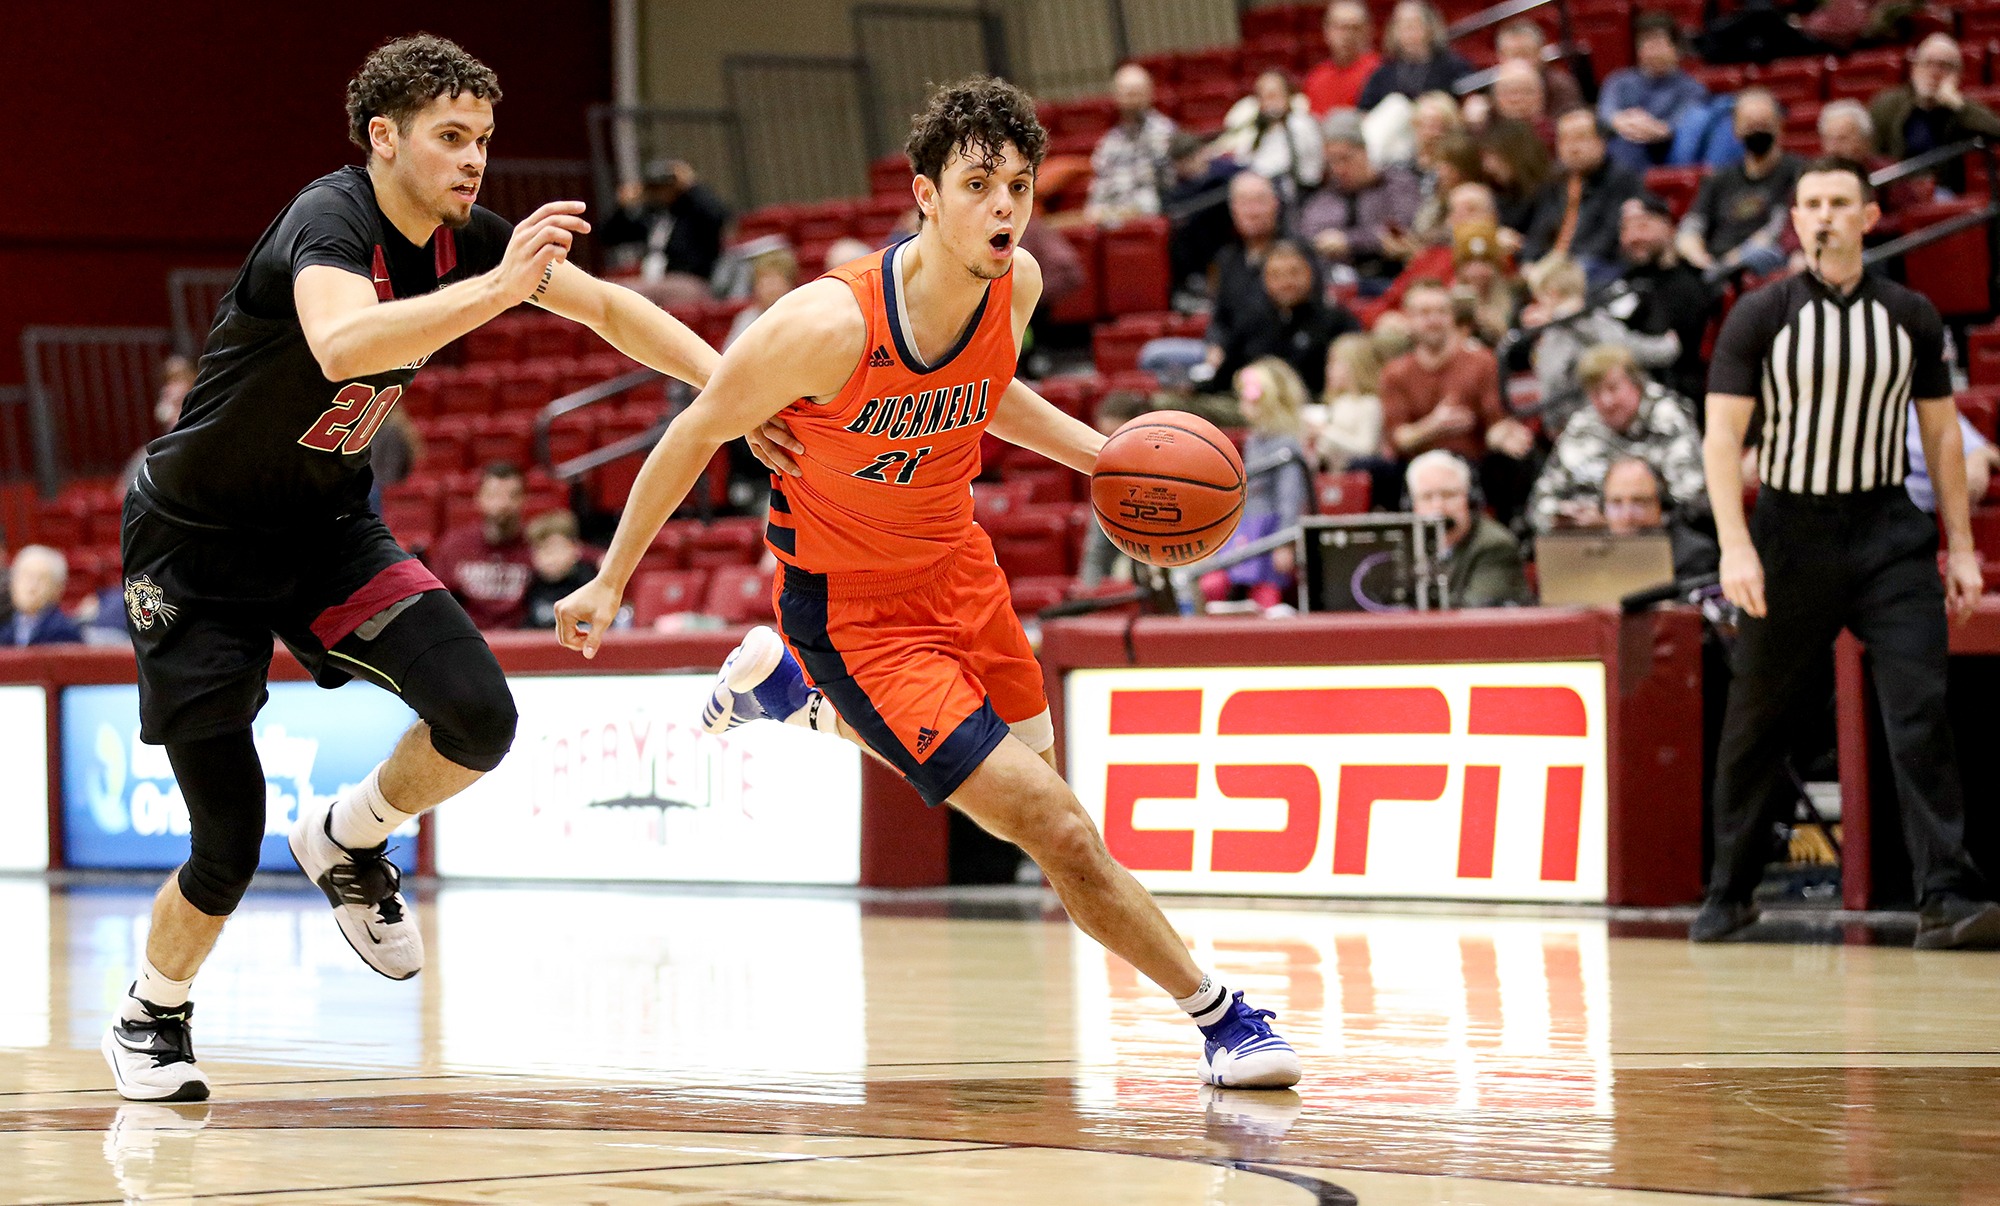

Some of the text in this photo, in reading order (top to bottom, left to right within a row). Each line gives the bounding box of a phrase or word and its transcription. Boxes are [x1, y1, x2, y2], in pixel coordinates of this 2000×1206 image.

[869, 358, 895, 368] adidas
[297, 382, 403, 455] 20
[843, 378, 990, 441] BUCKNELL
[851, 446, 933, 485] 21
[1161, 539, 1209, 563] THE
[917, 729, 940, 755] adidas
[1102, 685, 1588, 883] ESPN
